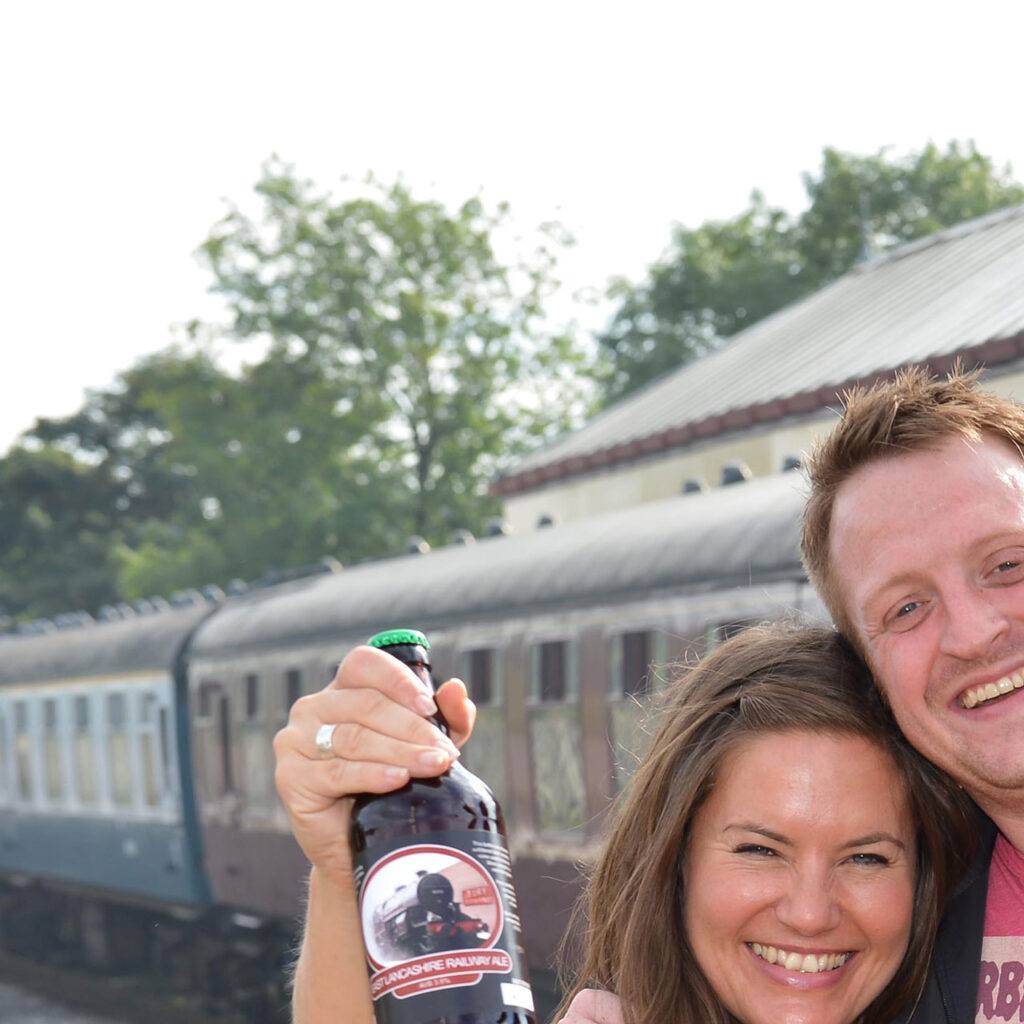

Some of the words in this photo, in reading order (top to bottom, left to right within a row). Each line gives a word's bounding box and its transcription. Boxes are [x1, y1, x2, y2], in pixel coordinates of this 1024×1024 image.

[383, 959, 445, 986] LANCASHIRE
[445, 955, 491, 969] RAILWAY
[491, 955, 509, 967] ALE
